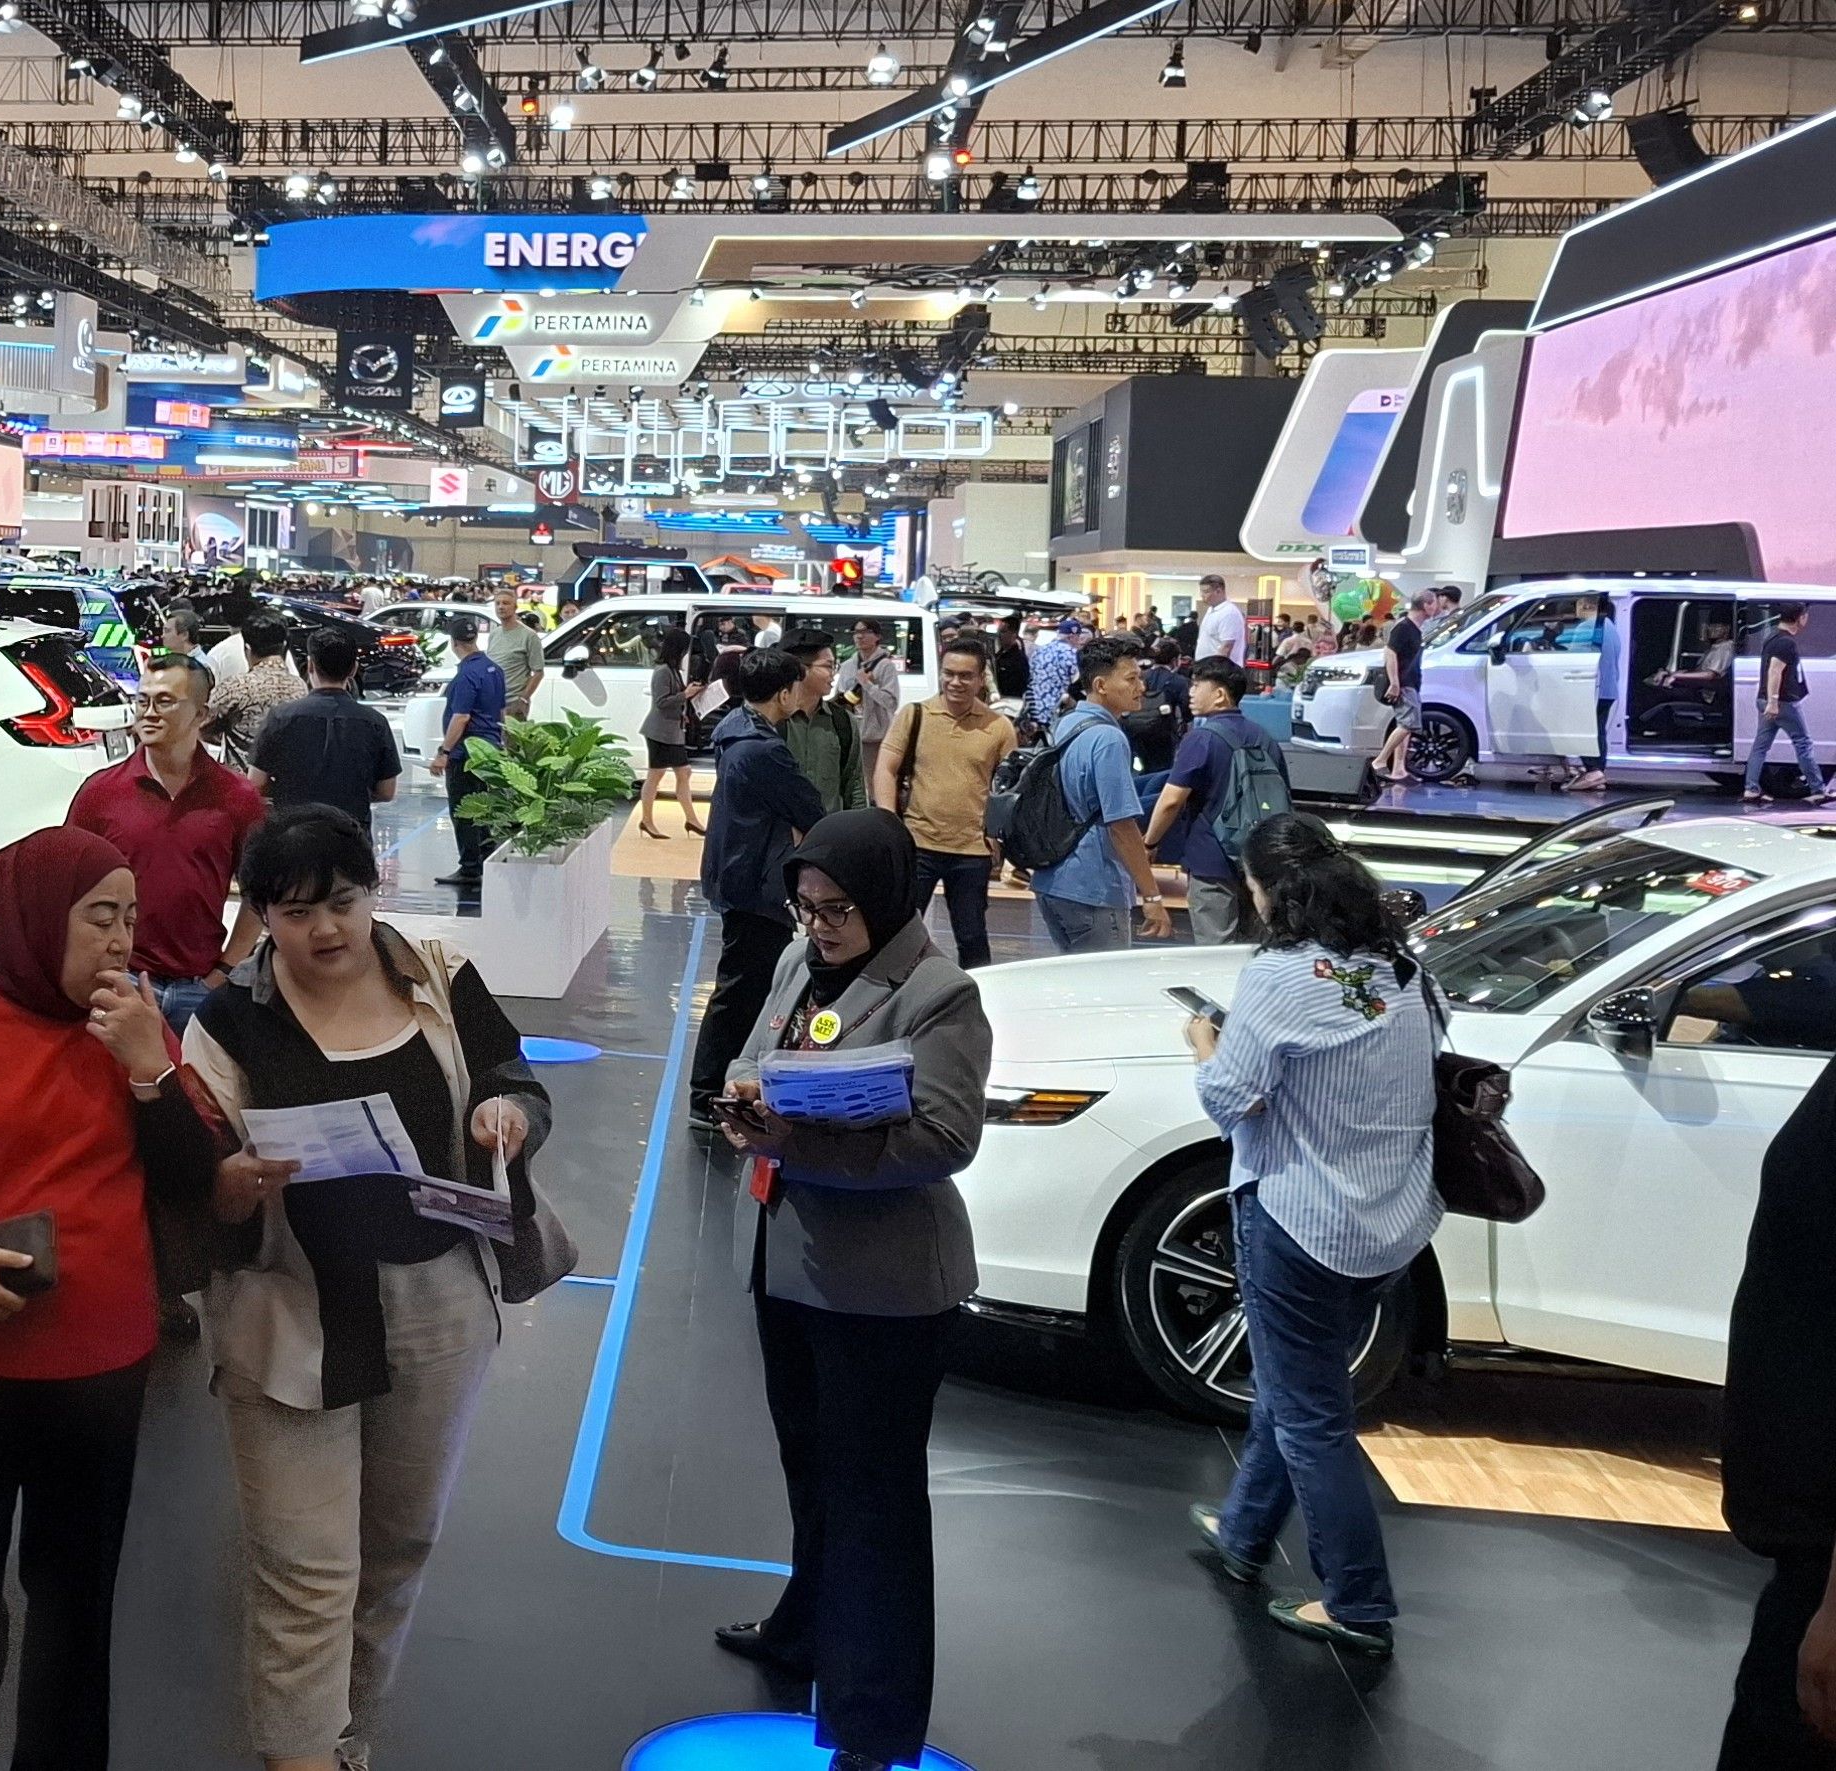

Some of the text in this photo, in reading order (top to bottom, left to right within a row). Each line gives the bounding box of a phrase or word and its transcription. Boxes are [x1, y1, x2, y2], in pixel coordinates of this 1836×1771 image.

[534, 315, 648, 331] PERTAMINA
[581, 359, 677, 373] PERTAMINA
[542, 470, 572, 495] MG
[1275, 544, 1324, 553] DEX
[816, 1016, 835, 1030] ASK
